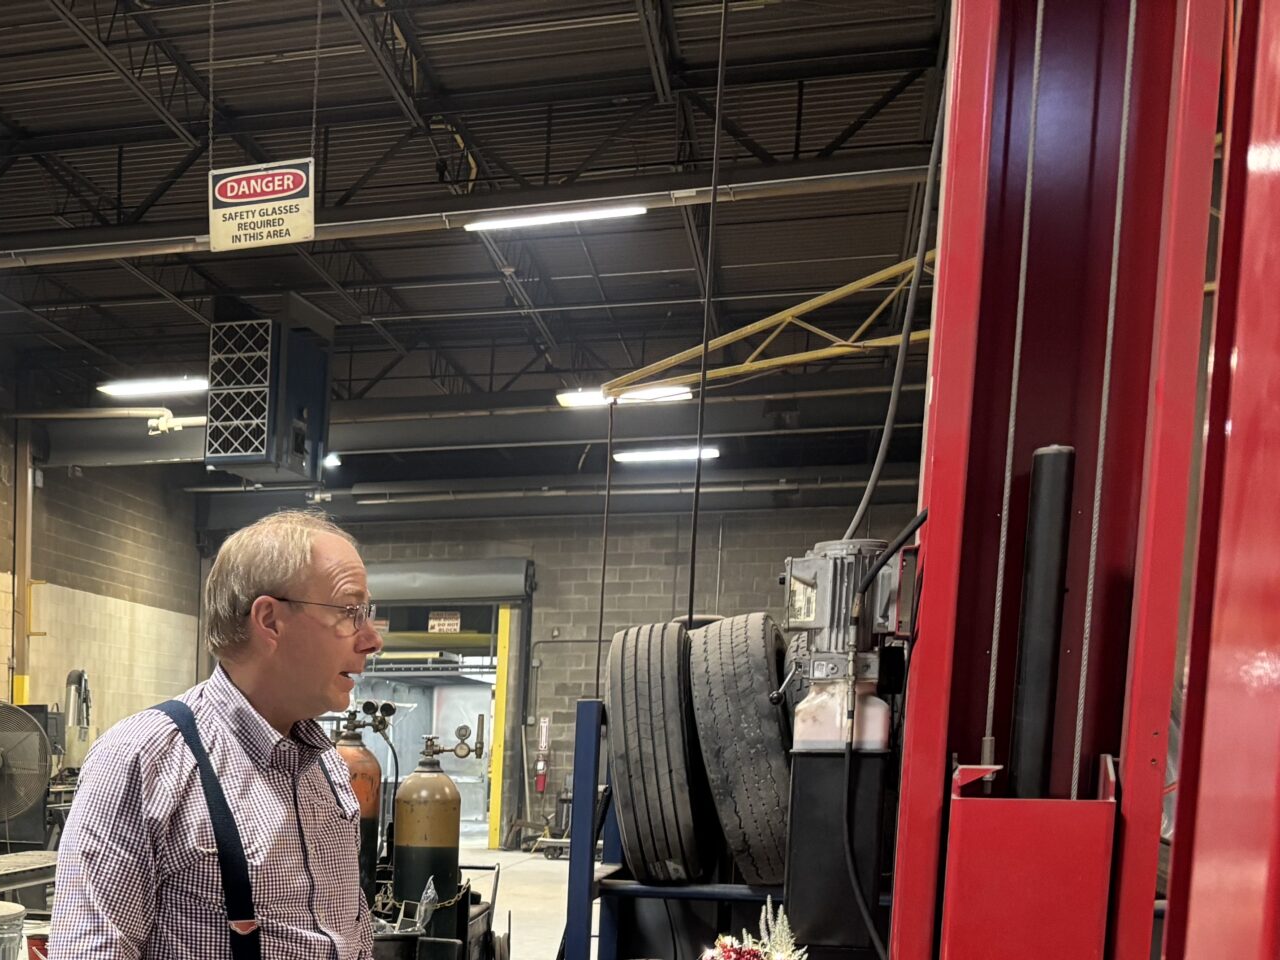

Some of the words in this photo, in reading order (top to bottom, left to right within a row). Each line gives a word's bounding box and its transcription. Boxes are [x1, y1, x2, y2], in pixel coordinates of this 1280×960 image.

[226, 174, 294, 197] DANGER
[222, 209, 257, 222] SAFETY
[258, 203, 300, 218] GLASSES
[237, 217, 285, 232] REQUIRED
[231, 234, 242, 244] IN
[243, 230, 264, 242] THIS
[266, 228, 291, 240] AREA
